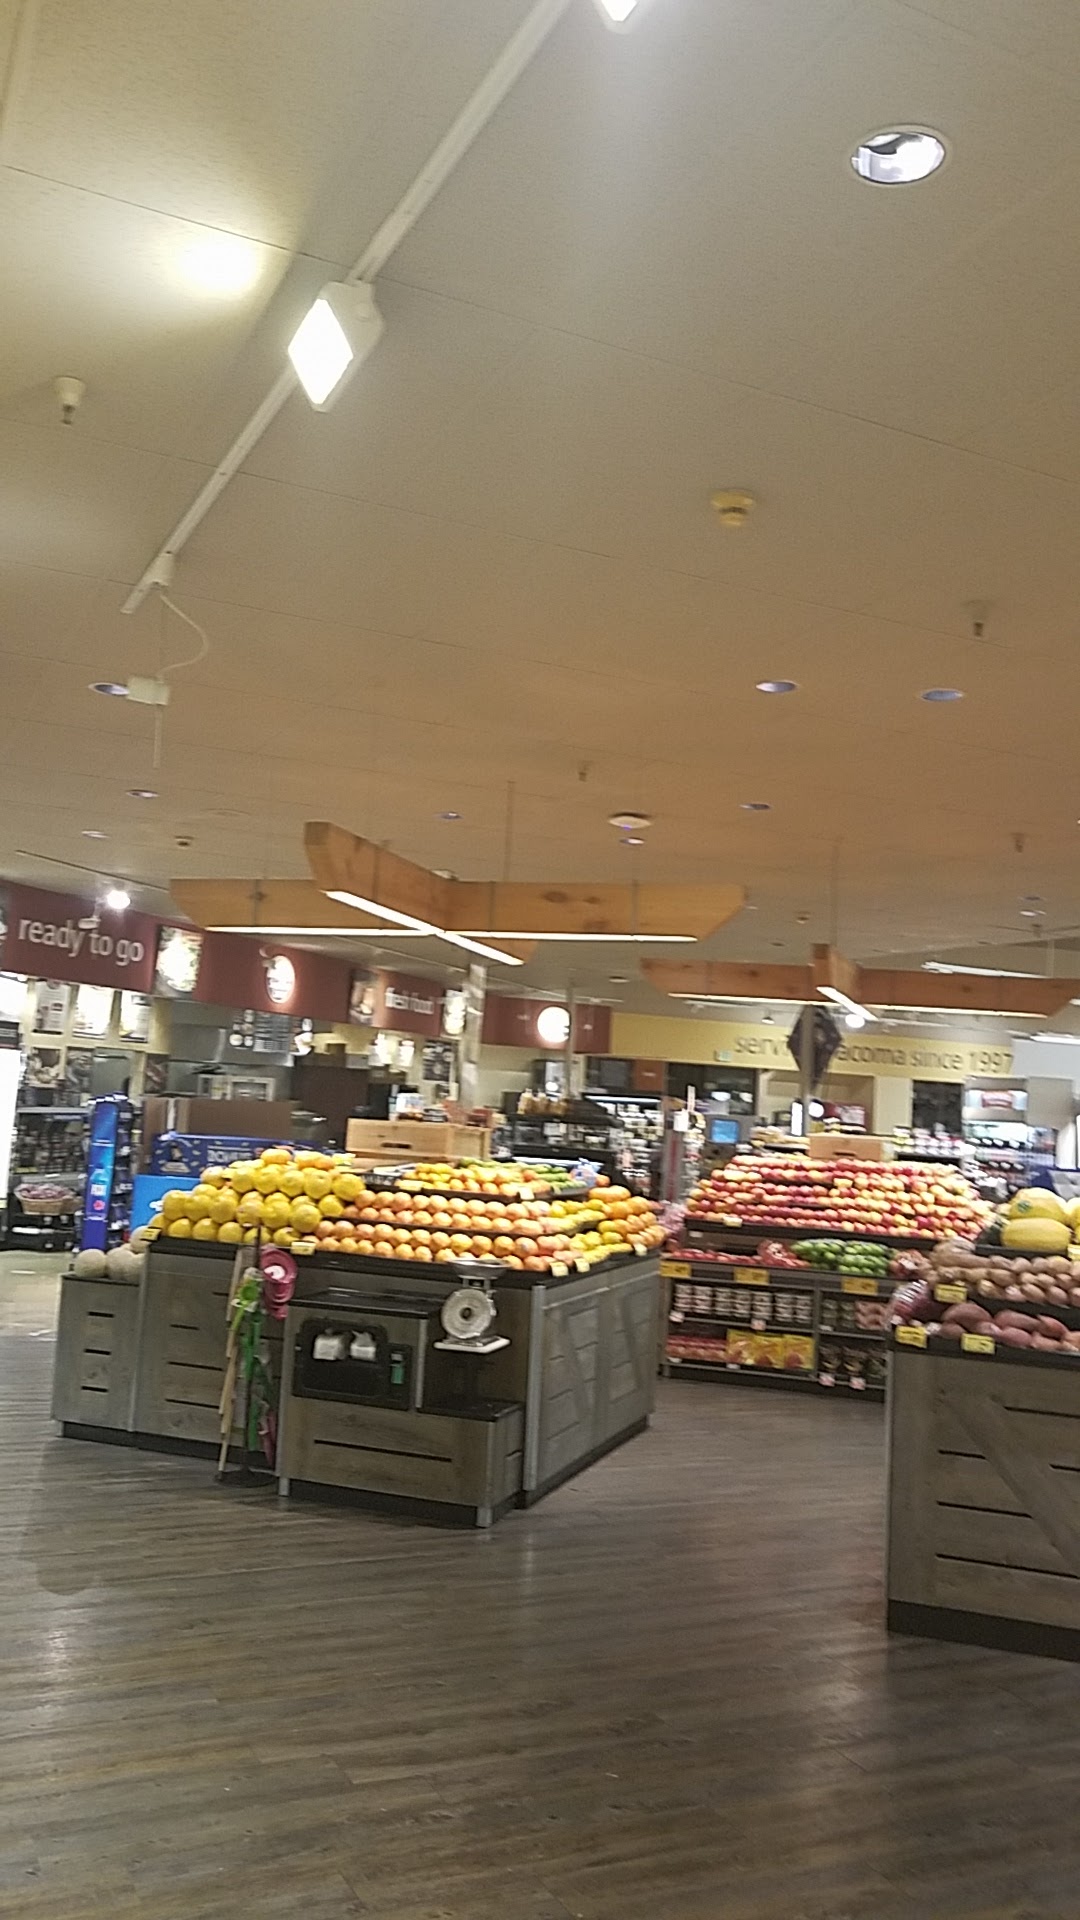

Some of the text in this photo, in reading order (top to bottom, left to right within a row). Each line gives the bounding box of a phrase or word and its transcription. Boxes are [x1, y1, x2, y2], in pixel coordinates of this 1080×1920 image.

[18, 919, 145, 966] ready to go
[835, 1043, 908, 1066] acoma
[910, 1051, 964, 1070] since
[969, 1051, 1014, 1074] 1997
